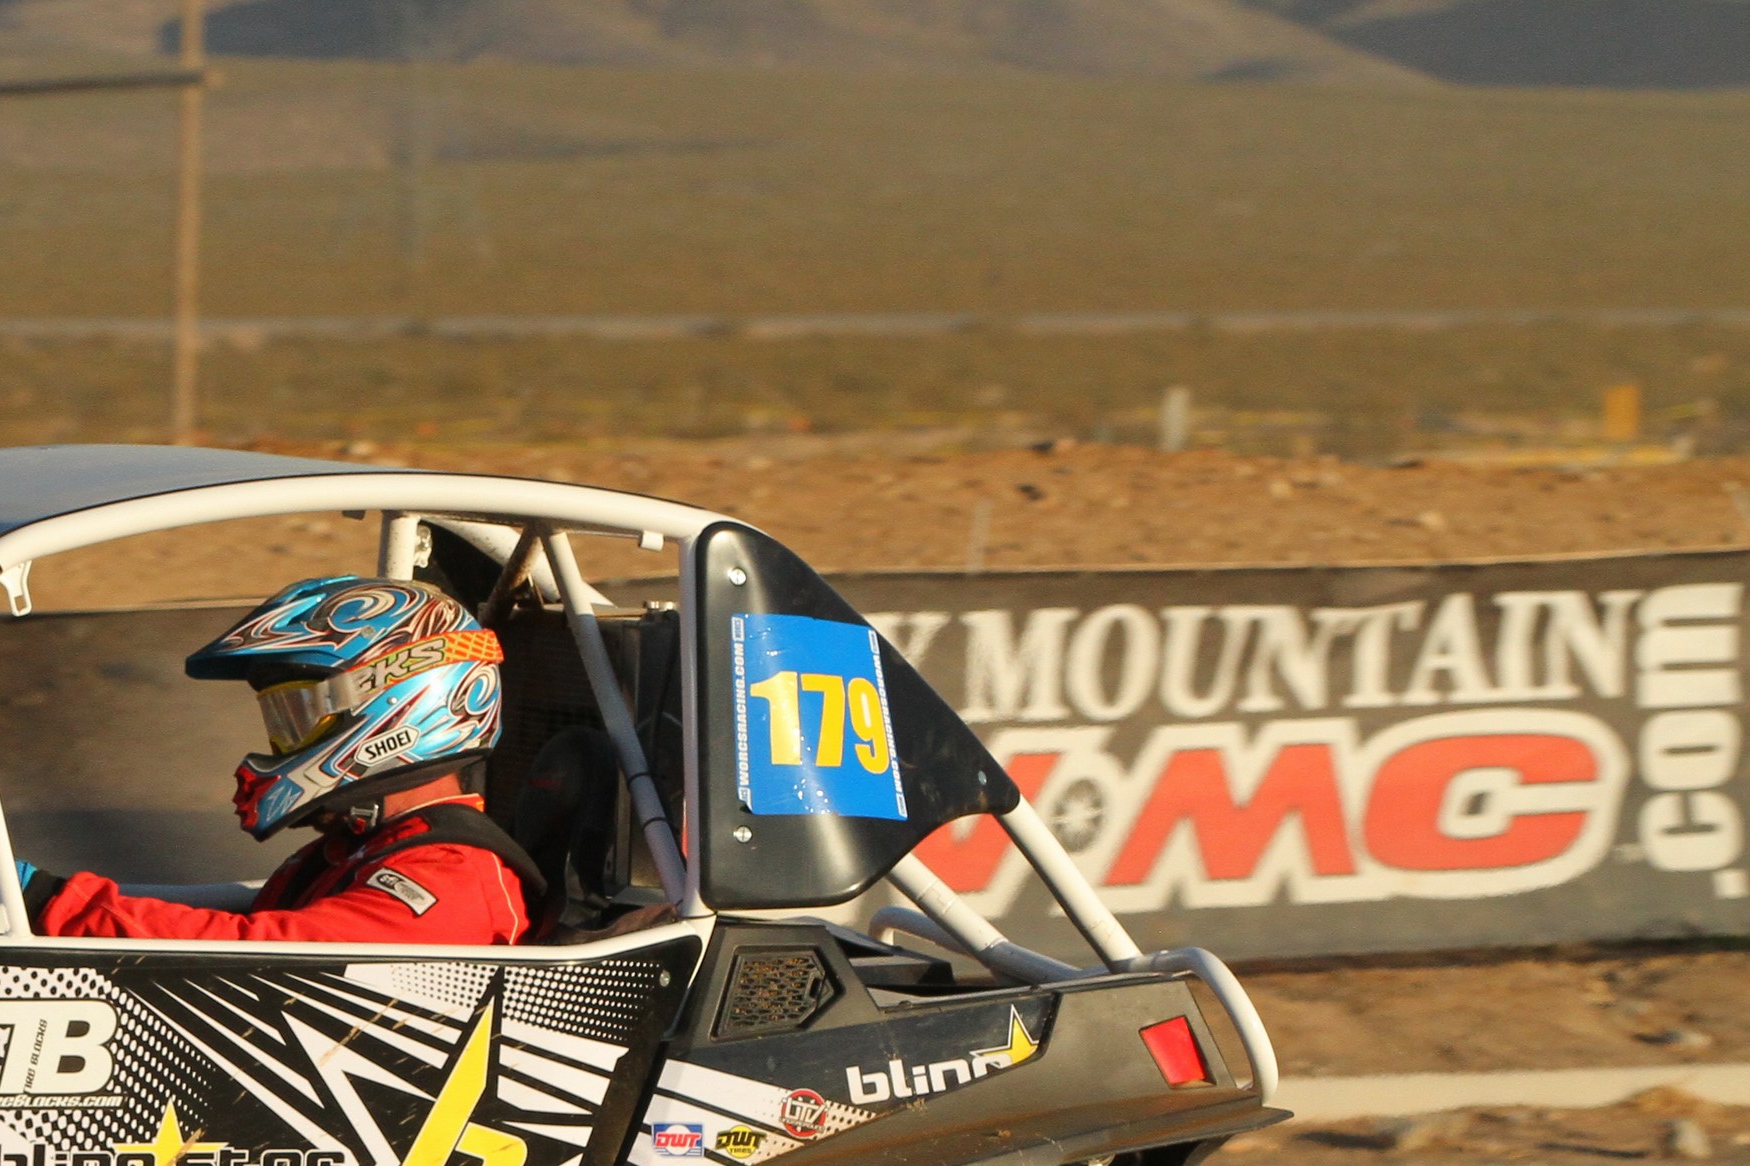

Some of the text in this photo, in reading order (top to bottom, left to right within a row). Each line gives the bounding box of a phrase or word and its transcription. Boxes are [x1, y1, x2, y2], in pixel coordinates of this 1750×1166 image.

[959, 589, 1644, 722] MOUNTAIN
[365, 730, 412, 760] SHOEI
[734, 643, 749, 785] WORCSRACING.COM
[750, 670, 890, 774] 179
[873, 655, 903, 793] WORCSRACING.COM
[1635, 582, 1747, 898] .com
[30, 1019, 48, 1066] BLOCKS
[655, 1134, 702, 1148] DWT
[715, 1129, 767, 1149] DWT
[784, 1097, 825, 1124] UTV
